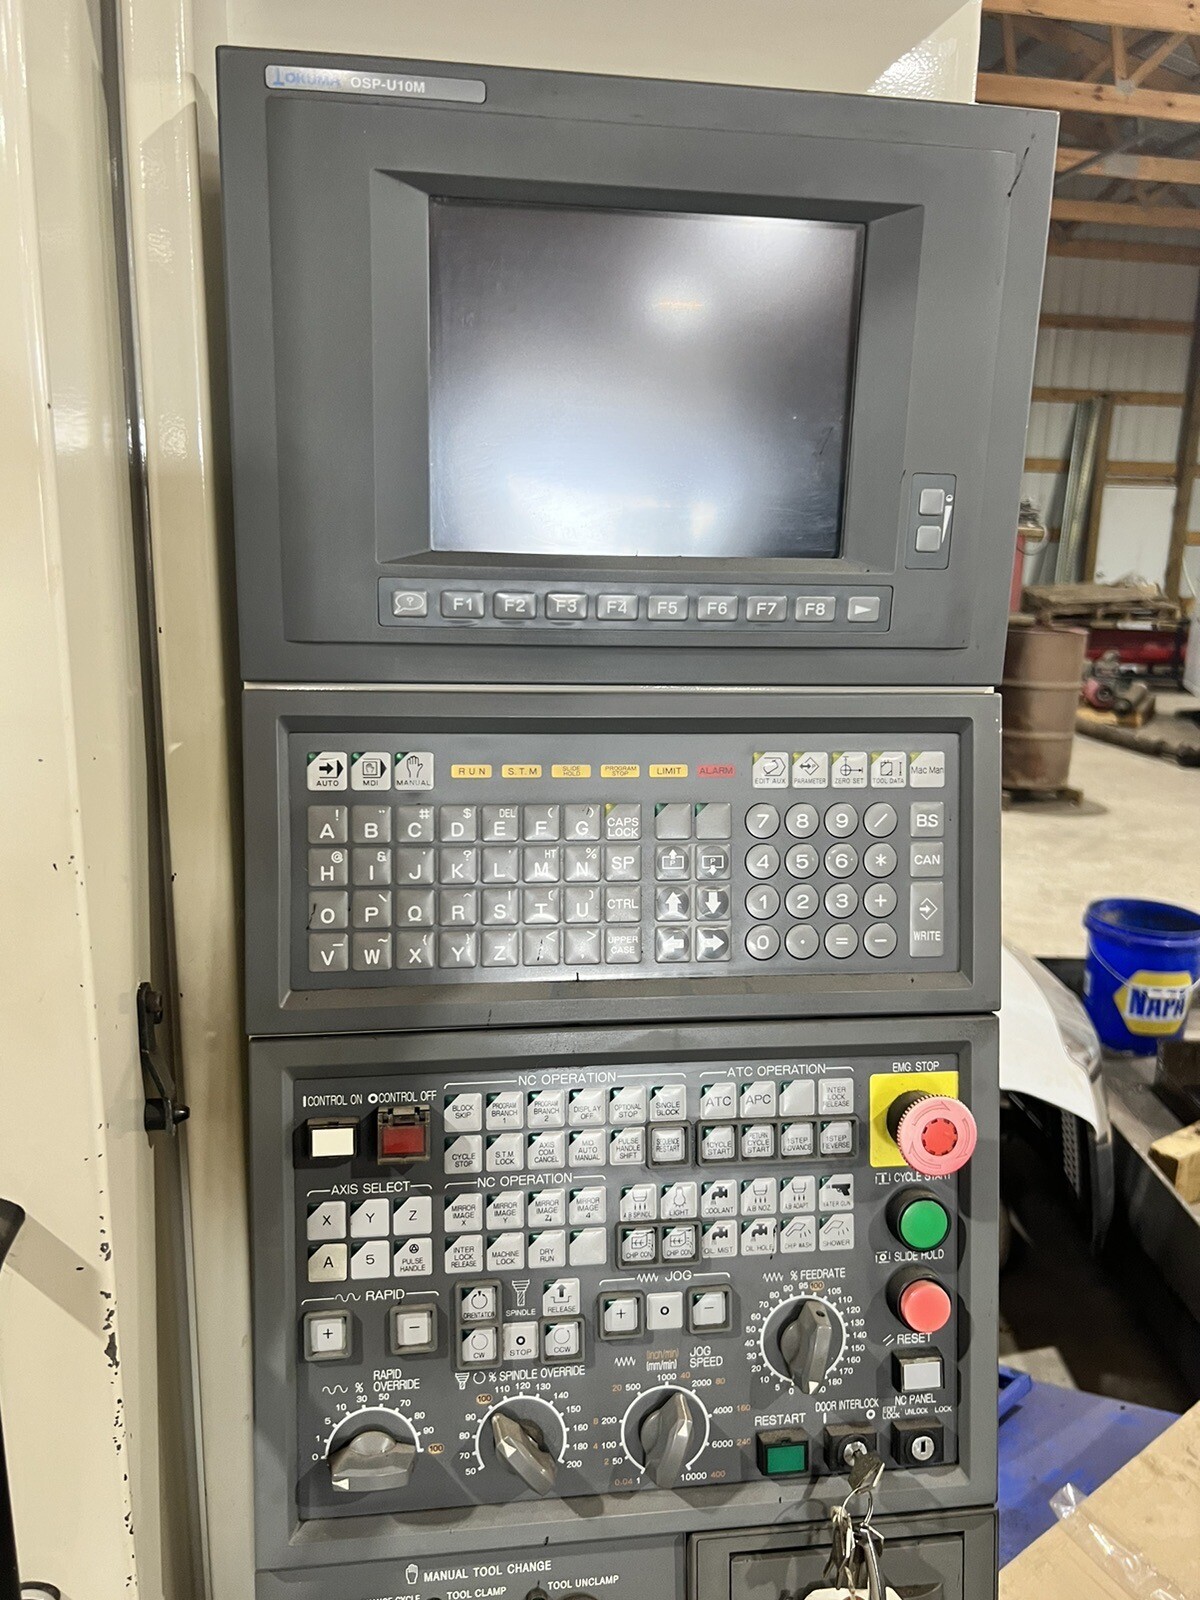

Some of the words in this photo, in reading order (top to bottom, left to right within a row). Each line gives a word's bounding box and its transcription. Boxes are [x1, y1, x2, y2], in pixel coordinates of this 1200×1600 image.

[350, 76, 426, 94] OSP-U10M
[454, 598, 472, 610] F1
[505, 600, 525, 612] F2
[556, 600, 576, 612] F3
[607, 601, 626, 613] F4
[657, 602, 677, 614] F5
[708, 603, 727, 614] F6
[757, 603, 776, 615] F7
[805, 603, 825, 615] F8
[657, 767, 681, 775] LIMIT
[911, 766, 927, 774] Mac
[607, 818, 639, 826] CAPS
[757, 814, 769, 828] 7
[796, 814, 809, 828] 8
[835, 814, 849, 828] 9
[916, 814, 938, 827] BS
[320, 824, 334, 838] A
[364, 824, 378, 838] B
[408, 823, 422, 837] C
[451, 823, 464, 837] D
[608, 828, 638, 837] LOCK
[612, 857, 634, 870] SP
[757, 855, 769, 869] 4
[796, 855, 808, 869] 5
[835, 854, 849, 868] 6
[914, 855, 940, 865] CAN
[607, 899, 638, 909] CTRL
[760, 895, 766, 909] 1
[797, 895, 808, 909] 2
[836, 894, 848, 908] 3
[608, 936, 638, 944] UPPER
[757, 935, 769, 949] 0
[913, 931, 940, 941] WRITE
[409, 949, 421, 963] X
[727, 1067, 753, 1077] ATC
[756, 1064, 826, 1076] OPERATION
[892, 1063, 913, 1072] EMG.
[916, 1061, 939, 1071] STOP
[518, 1075, 536, 1086] NC
[541, 1072, 616, 1085] OPERATION
[308, 1095, 348, 1107] CONTROL
[351, 1095, 362, 1104] ON
[379, 1092, 418, 1103] CONTROL
[421, 1091, 436, 1101] OFF
[706, 1096, 732, 1106] ATC
[746, 1094, 771, 1104] APC
[477, 1177, 496, 1188] NC
[500, 1173, 572, 1186] OPERATION
[894, 1172, 921, 1182] CYCLE
[331, 1184, 358, 1195] AXIS
[363, 1181, 410, 1193] SELECT
[323, 1215, 331, 1226] X
[366, 1213, 375, 1223] Y
[409, 1210, 417, 1221] Z
[366, 1254, 374, 1264] 5
[492, 1250, 520, 1258] MACHINE
[894, 1251, 918, 1261] SLIDE
[921, 1249, 944, 1260] HOLD
[323, 1256, 333, 1268] A
[400, 1264, 425, 1272] HANDLE
[665, 1270, 692, 1281] JOG
[801, 1268, 845, 1280] FEEDRATE
[366, 1289, 405, 1300] RAPID
[506, 1308, 536, 1316] SPINDLE
[897, 1332, 932, 1344] RESET
[690, 1346, 711, 1357] JOG
[690, 1356, 723, 1368] SPEED
[373, 1368, 401, 1380] RAPID
[500, 1368, 537, 1381] SPINDLE
[540, 1365, 585, 1378] OVERRIDE
[657, 1373, 676, 1381] 1000
[373, 1378, 420, 1392] OVERRIDE
[495, 1385, 510, 1393] 110
[516, 1382, 530, 1390] 120
[692, 1379, 711, 1387] 2000
[815, 1401, 836, 1412] DOOR
[839, 1398, 879, 1410] INTERLOCK
[895, 1395, 906, 1405] NC
[909, 1393, 936, 1404] PANEL
[566, 1405, 581, 1413] 150
[713, 1406, 733, 1414] 4000
[905, 1407, 928, 1415] UNLOCK
[755, 1413, 806, 1426] RESTART
[430, 1444, 443, 1452] 100
[712, 1440, 733, 1448] 6000
[566, 1460, 582, 1468] 200
[681, 1472, 707, 1481] 10000
[424, 1568, 468, 1582] MANUAL
[473, 1565, 502, 1577] TOOL
[507, 1560, 552, 1573] CHANGE
[548, 1580, 572, 1591] TOOL
[575, 1575, 619, 1587] UNCLAMP
[447, 1590, 473, 1600] TOOL
[475, 1586, 507, 1598] CLAMP
